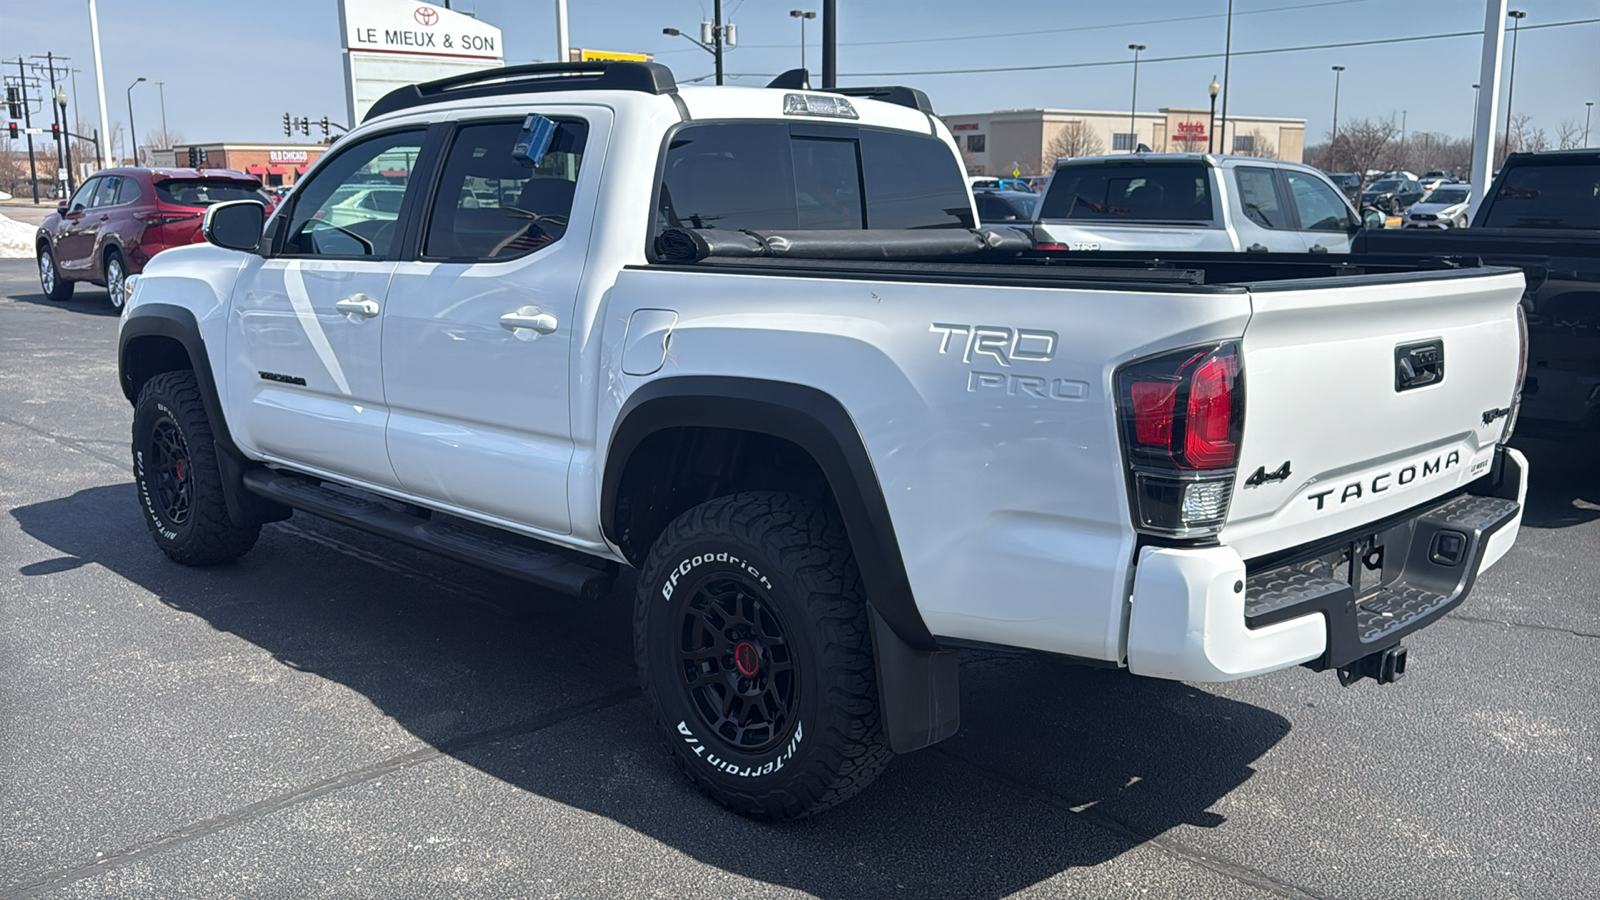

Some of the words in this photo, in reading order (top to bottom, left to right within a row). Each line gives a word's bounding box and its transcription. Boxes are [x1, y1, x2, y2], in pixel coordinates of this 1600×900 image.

[357, 28, 377, 43] LE
[385, 30, 436, 47] MIEUX
[443, 33, 454, 48] &
[461, 35, 495, 51] SON
[270, 151, 282, 161] OLD
[283, 151, 307, 161] CHICAGO
[929, 322, 1060, 367] TRD
[258, 371, 307, 387] TACOMA
[967, 371, 1090, 402] PRO
[1307, 450, 1460, 511] TACOMA
[661, 551, 774, 602] BFGoodrich
[677, 719, 706, 757] T/A
[707, 719, 804, 777] All-Terrain
